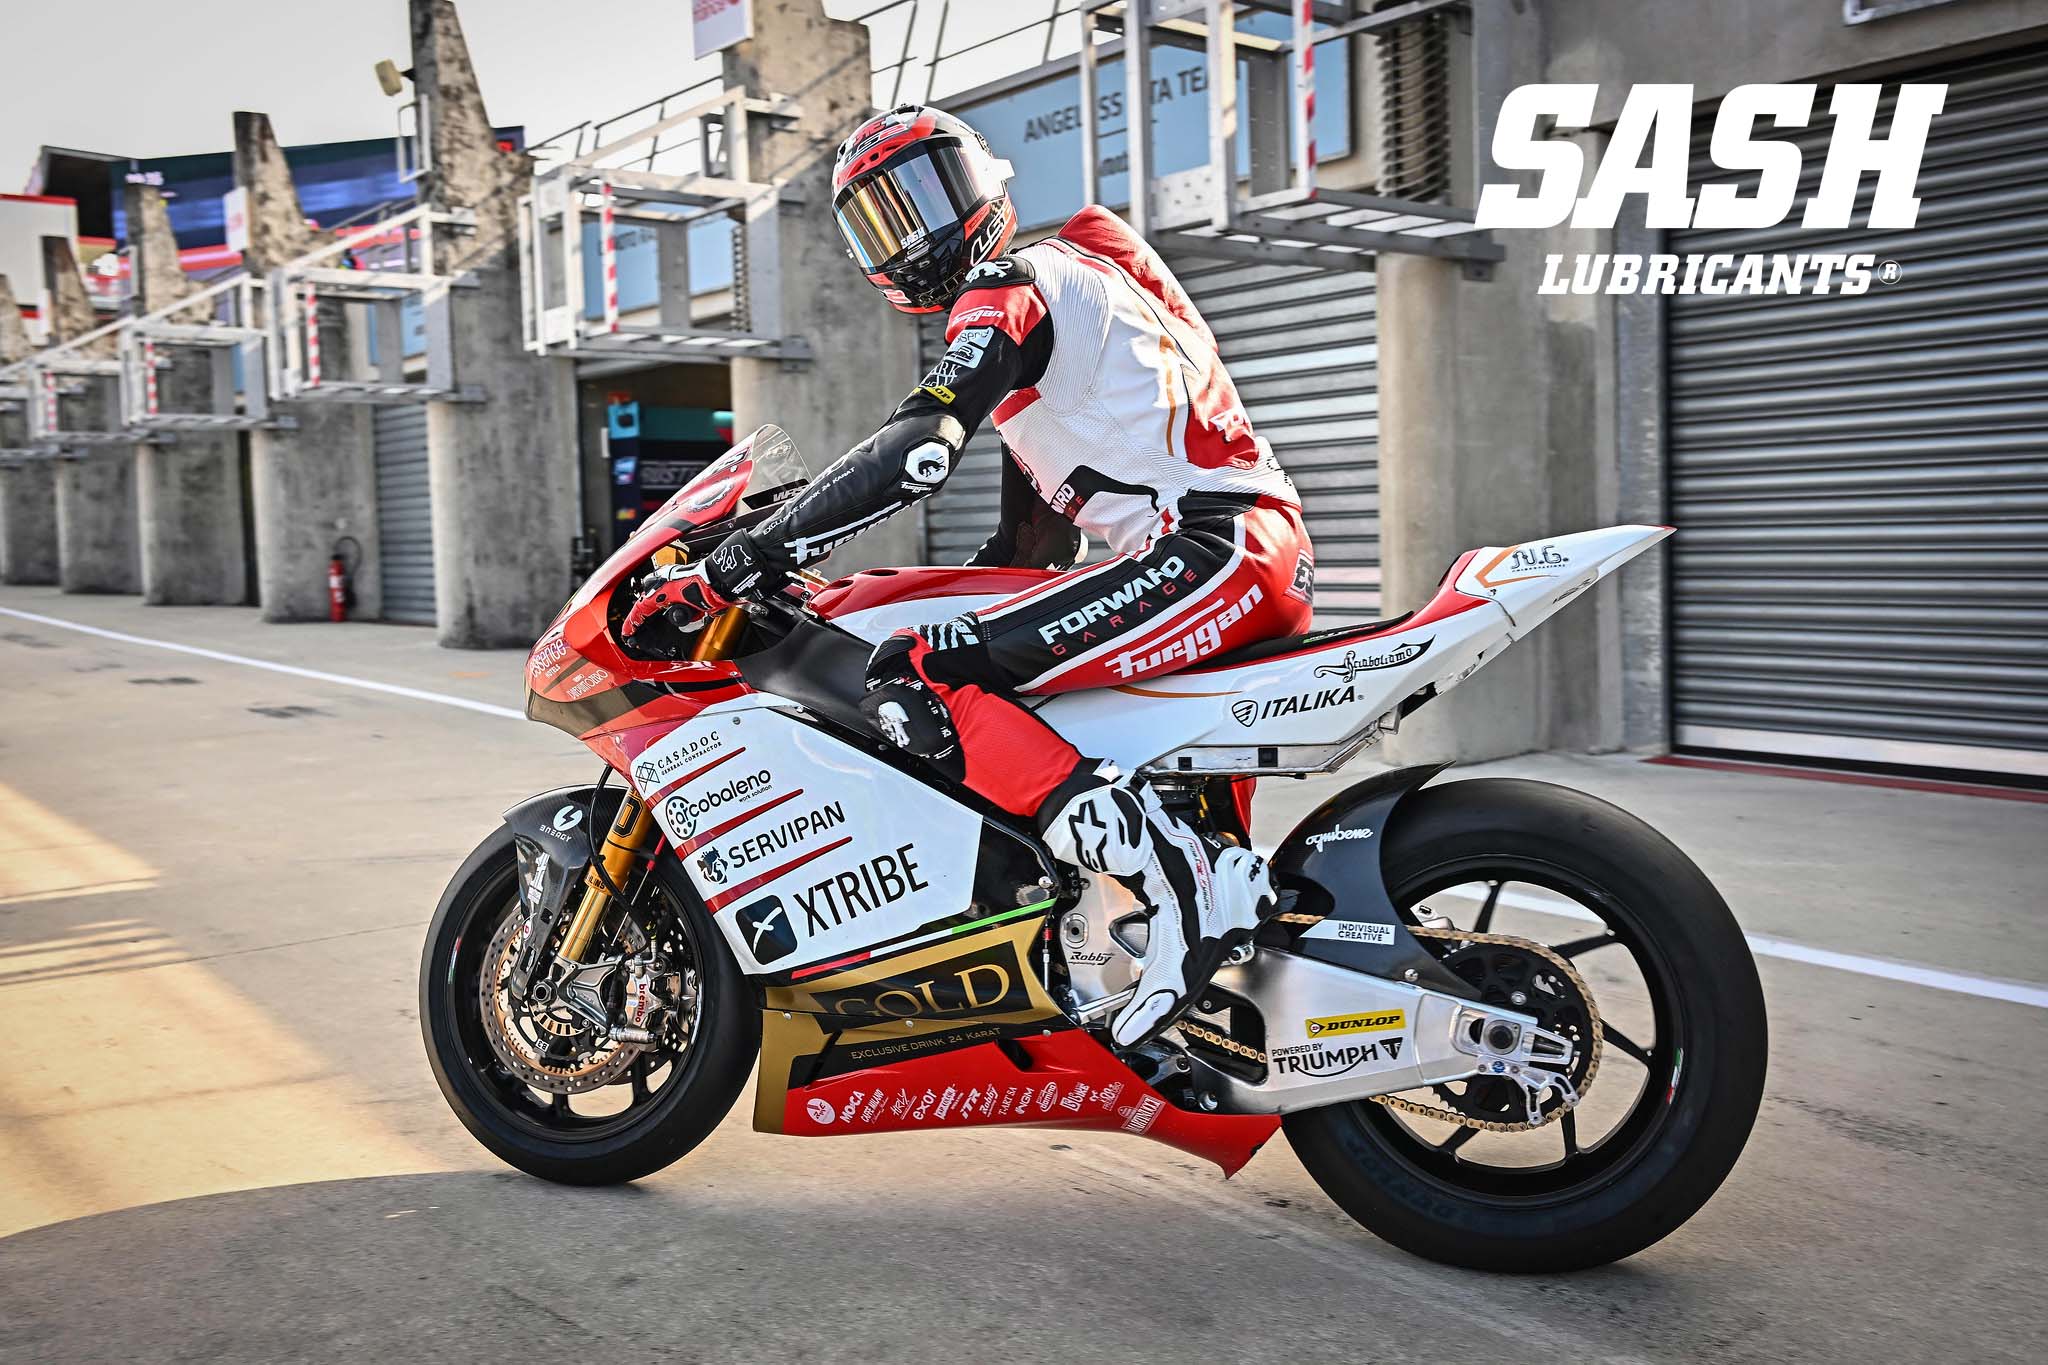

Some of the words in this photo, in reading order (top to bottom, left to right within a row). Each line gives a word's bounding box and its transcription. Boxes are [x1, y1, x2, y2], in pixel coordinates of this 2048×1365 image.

[1024, 92, 1123, 142] ANGELSS
[1038, 555, 1185, 645] FORWARD
[657, 731, 720, 769] CASADOC
[684, 741, 722, 763] CONTRACTOR
[675, 769, 771, 825] arcobaleno
[752, 784, 772, 797] solution
[729, 800, 846, 869] SERVIPAN
[793, 843, 929, 938] XTRIBE
[1337, 930, 1383, 942] CREATIVE
[1338, 922, 1391, 936] INDIVISUAL
[635, 983, 647, 1023] brembo
[835, 964, 1011, 1018] GOLD
[1327, 1015, 1401, 1031] DUNLOP
[851, 1043, 910, 1060] EXCLUSIVE
[910, 1037, 945, 1051] DRINK
[949, 1034, 964, 1044] 24
[967, 1027, 1002, 1040] KARAT
[1272, 1045, 1310, 1057] POWERED
[1312, 1042, 1324, 1053] BY
[1272, 1043, 1379, 1078] TRIUMPH
[840, 1090, 865, 1123] MOCA
